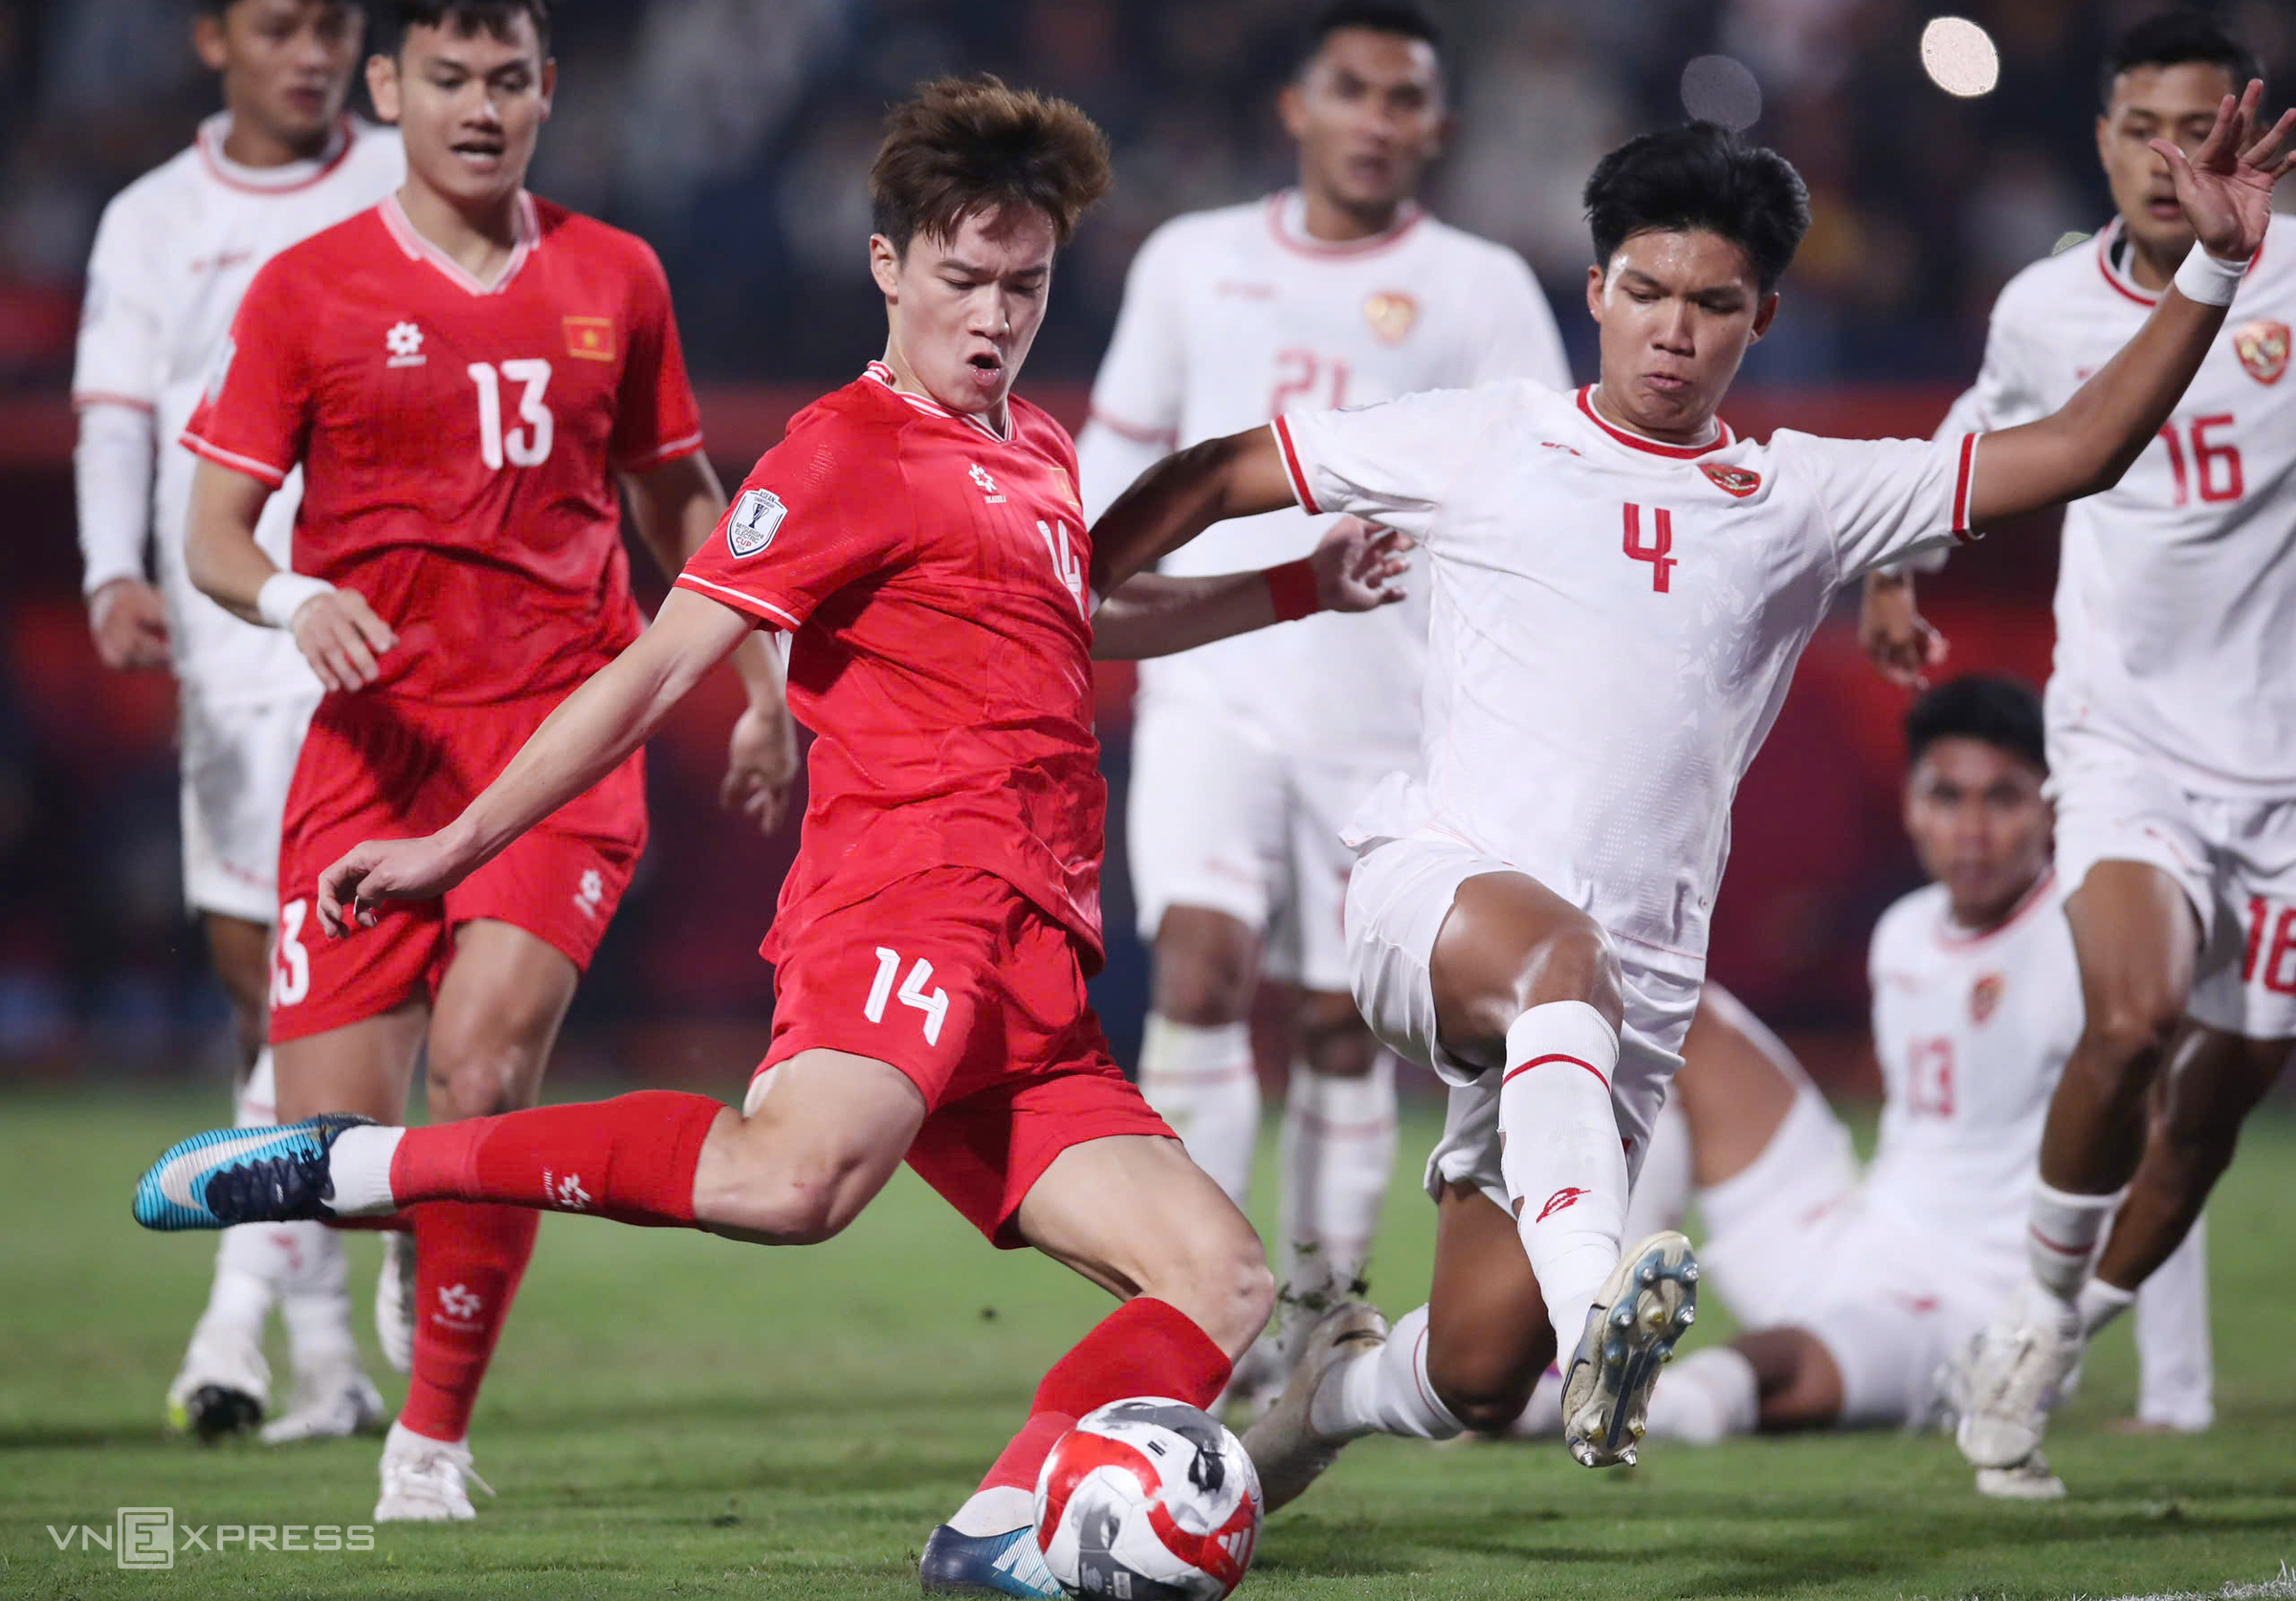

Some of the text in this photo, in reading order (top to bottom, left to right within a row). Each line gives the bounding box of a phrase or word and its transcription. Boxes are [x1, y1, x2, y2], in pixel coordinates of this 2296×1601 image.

[467, 359, 554, 471] 13
[1268, 346, 1352, 421] 21
[759, 491, 776, 503] ASEAN
[2158, 413, 2244, 510] 16
[735, 528, 760, 544] ELECTRIC
[736, 521, 765, 540] MITSUBISHI
[736, 537, 752, 547] CUP
[1036, 519, 1085, 622] 14
[1623, 502, 1678, 594] 4
[864, 946, 950, 1047] 14
